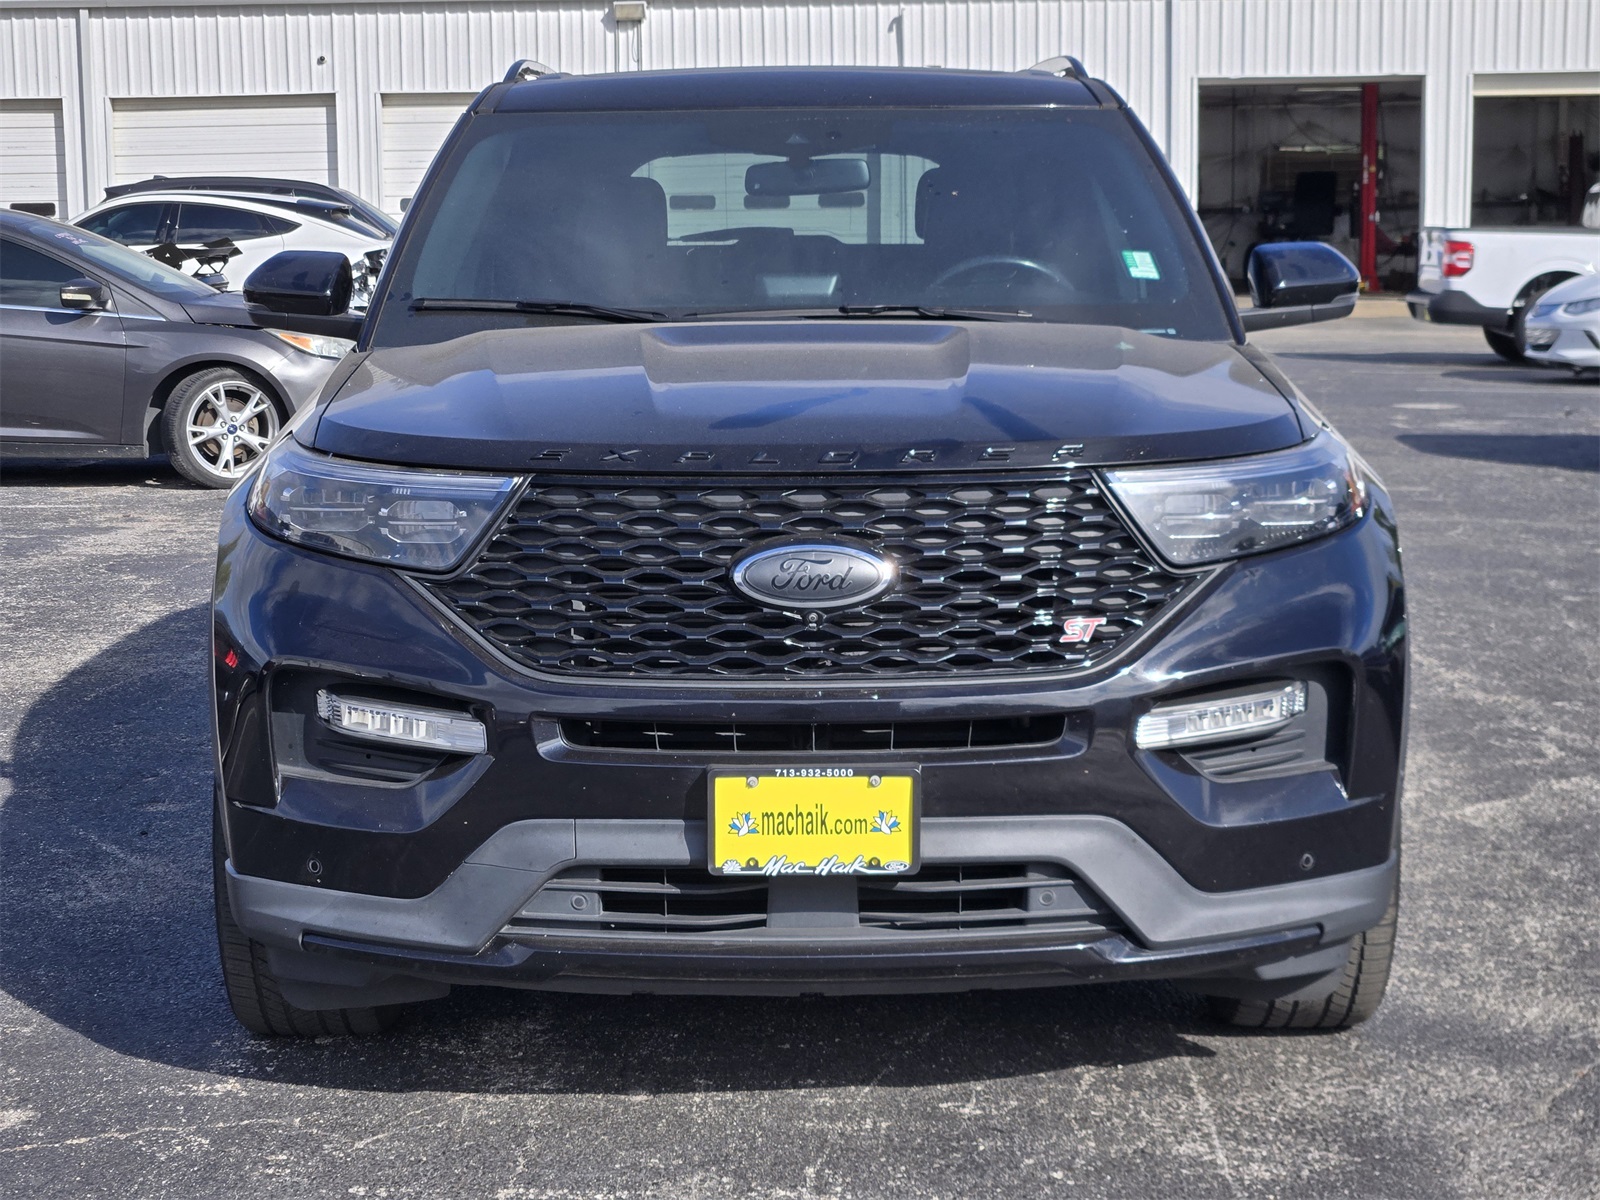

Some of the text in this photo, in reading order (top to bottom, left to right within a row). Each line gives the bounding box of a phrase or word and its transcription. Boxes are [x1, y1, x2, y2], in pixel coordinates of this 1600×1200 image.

[529, 443, 1085, 465] EXPLORER
[771, 557, 853, 591] Ford
[1059, 617, 1107, 643] ST
[774, 768, 854, 778] 713-932-5000
[761, 803, 868, 836] machaik.com
[762, 854, 868, 877] Mac Haik
